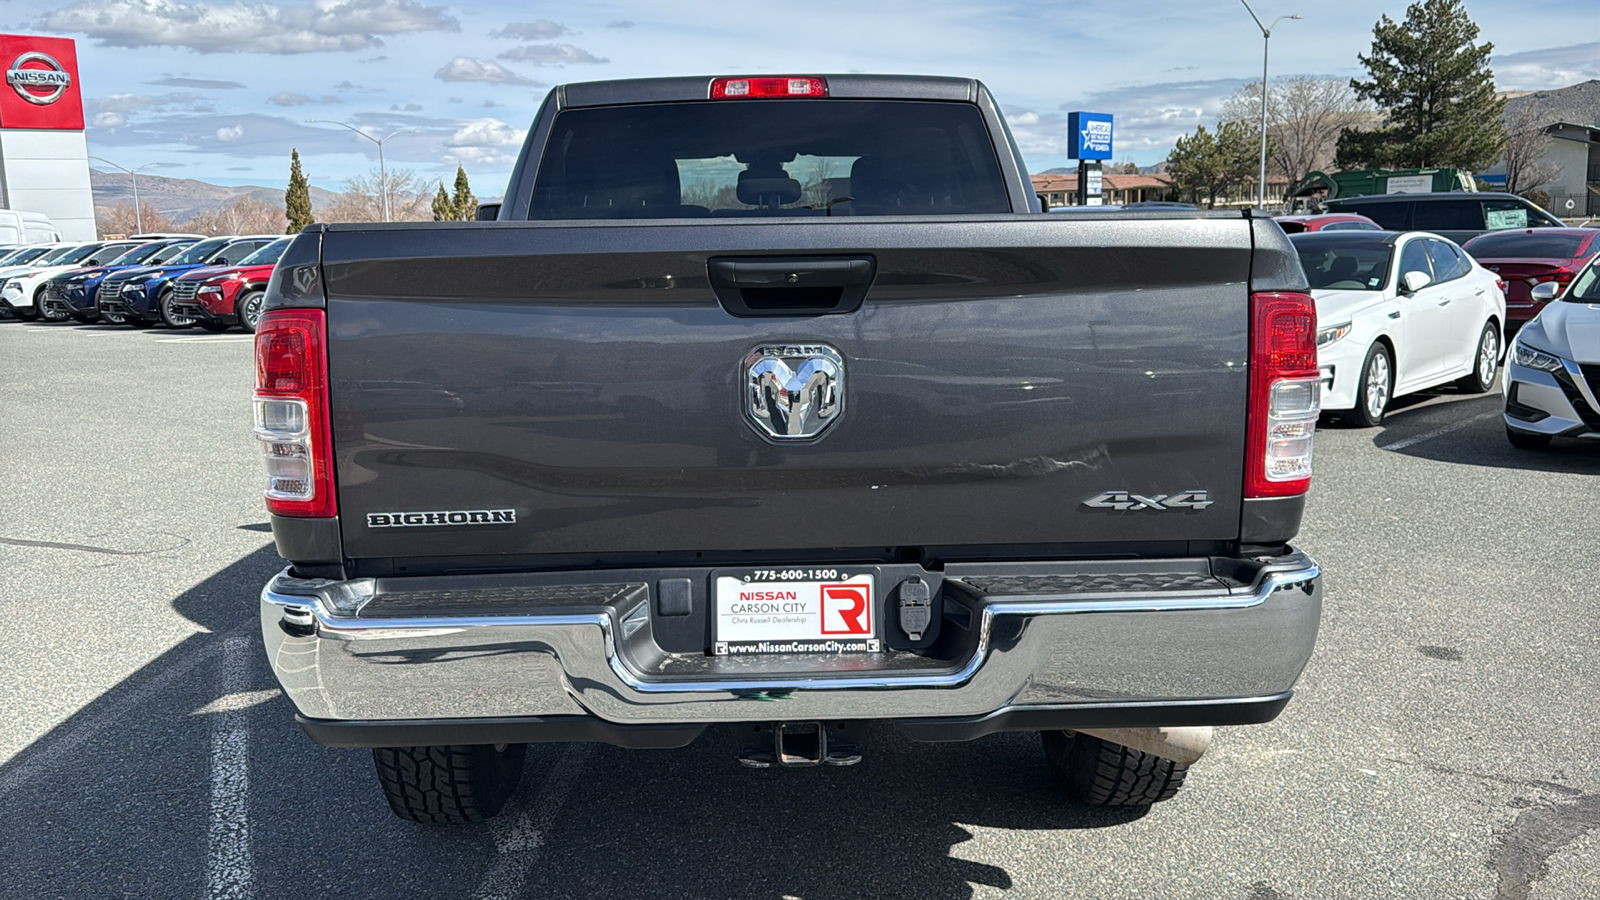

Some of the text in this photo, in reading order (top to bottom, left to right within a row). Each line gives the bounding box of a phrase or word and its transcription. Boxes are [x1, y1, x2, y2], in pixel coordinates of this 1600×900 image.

[14, 72, 65, 83] NISSAN
[763, 346, 823, 356] RAM
[367, 509, 516, 528] BIGHORN
[754, 569, 837, 581] 775-600-1500
[740, 591, 797, 601] NISSAN
[731, 602, 807, 614] CARSON CITY
[731, 615, 807, 625] Chris Russell Dealership
[729, 640, 866, 655] www.NissanCarsonCity.com
